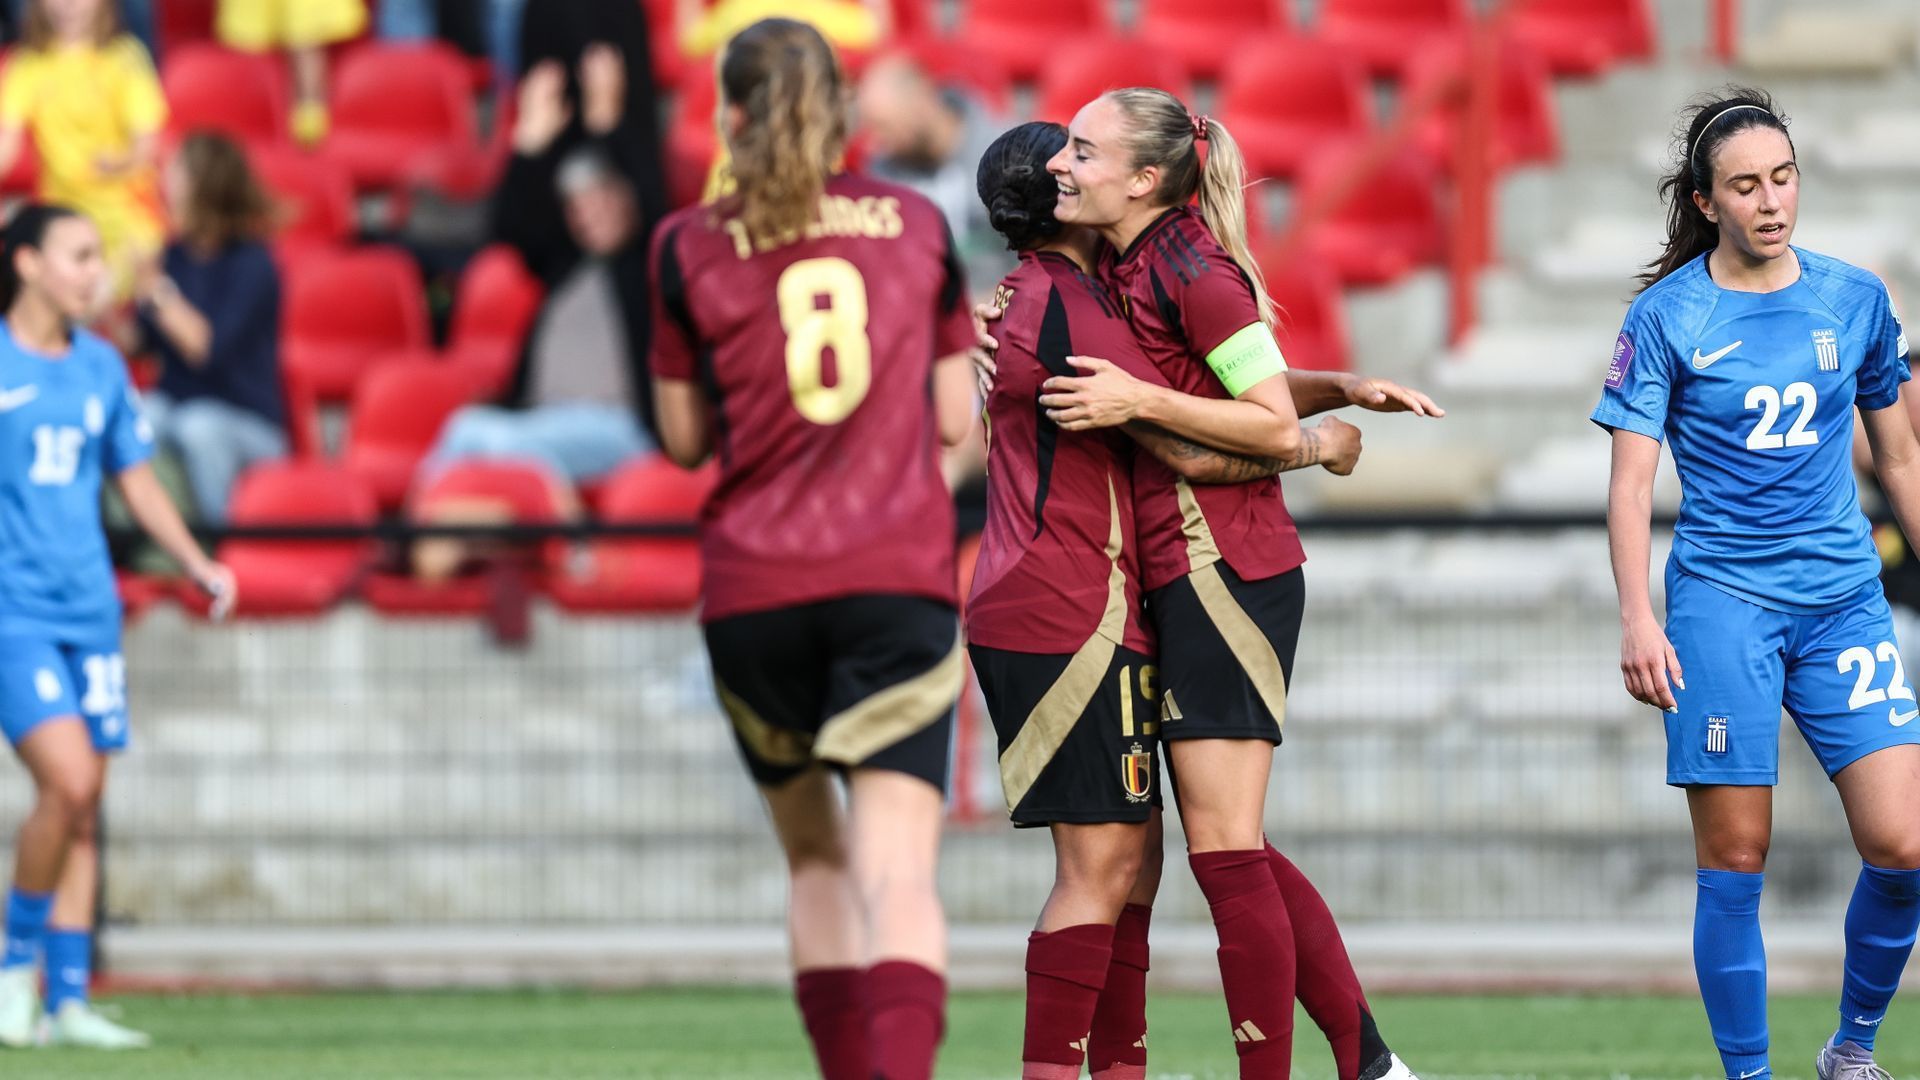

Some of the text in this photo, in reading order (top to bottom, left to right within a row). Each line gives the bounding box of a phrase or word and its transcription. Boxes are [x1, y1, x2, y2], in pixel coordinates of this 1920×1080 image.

[776, 256, 872, 426] 8
[1744, 381, 1819, 451] 22
[1837, 641, 1916, 711] 22
